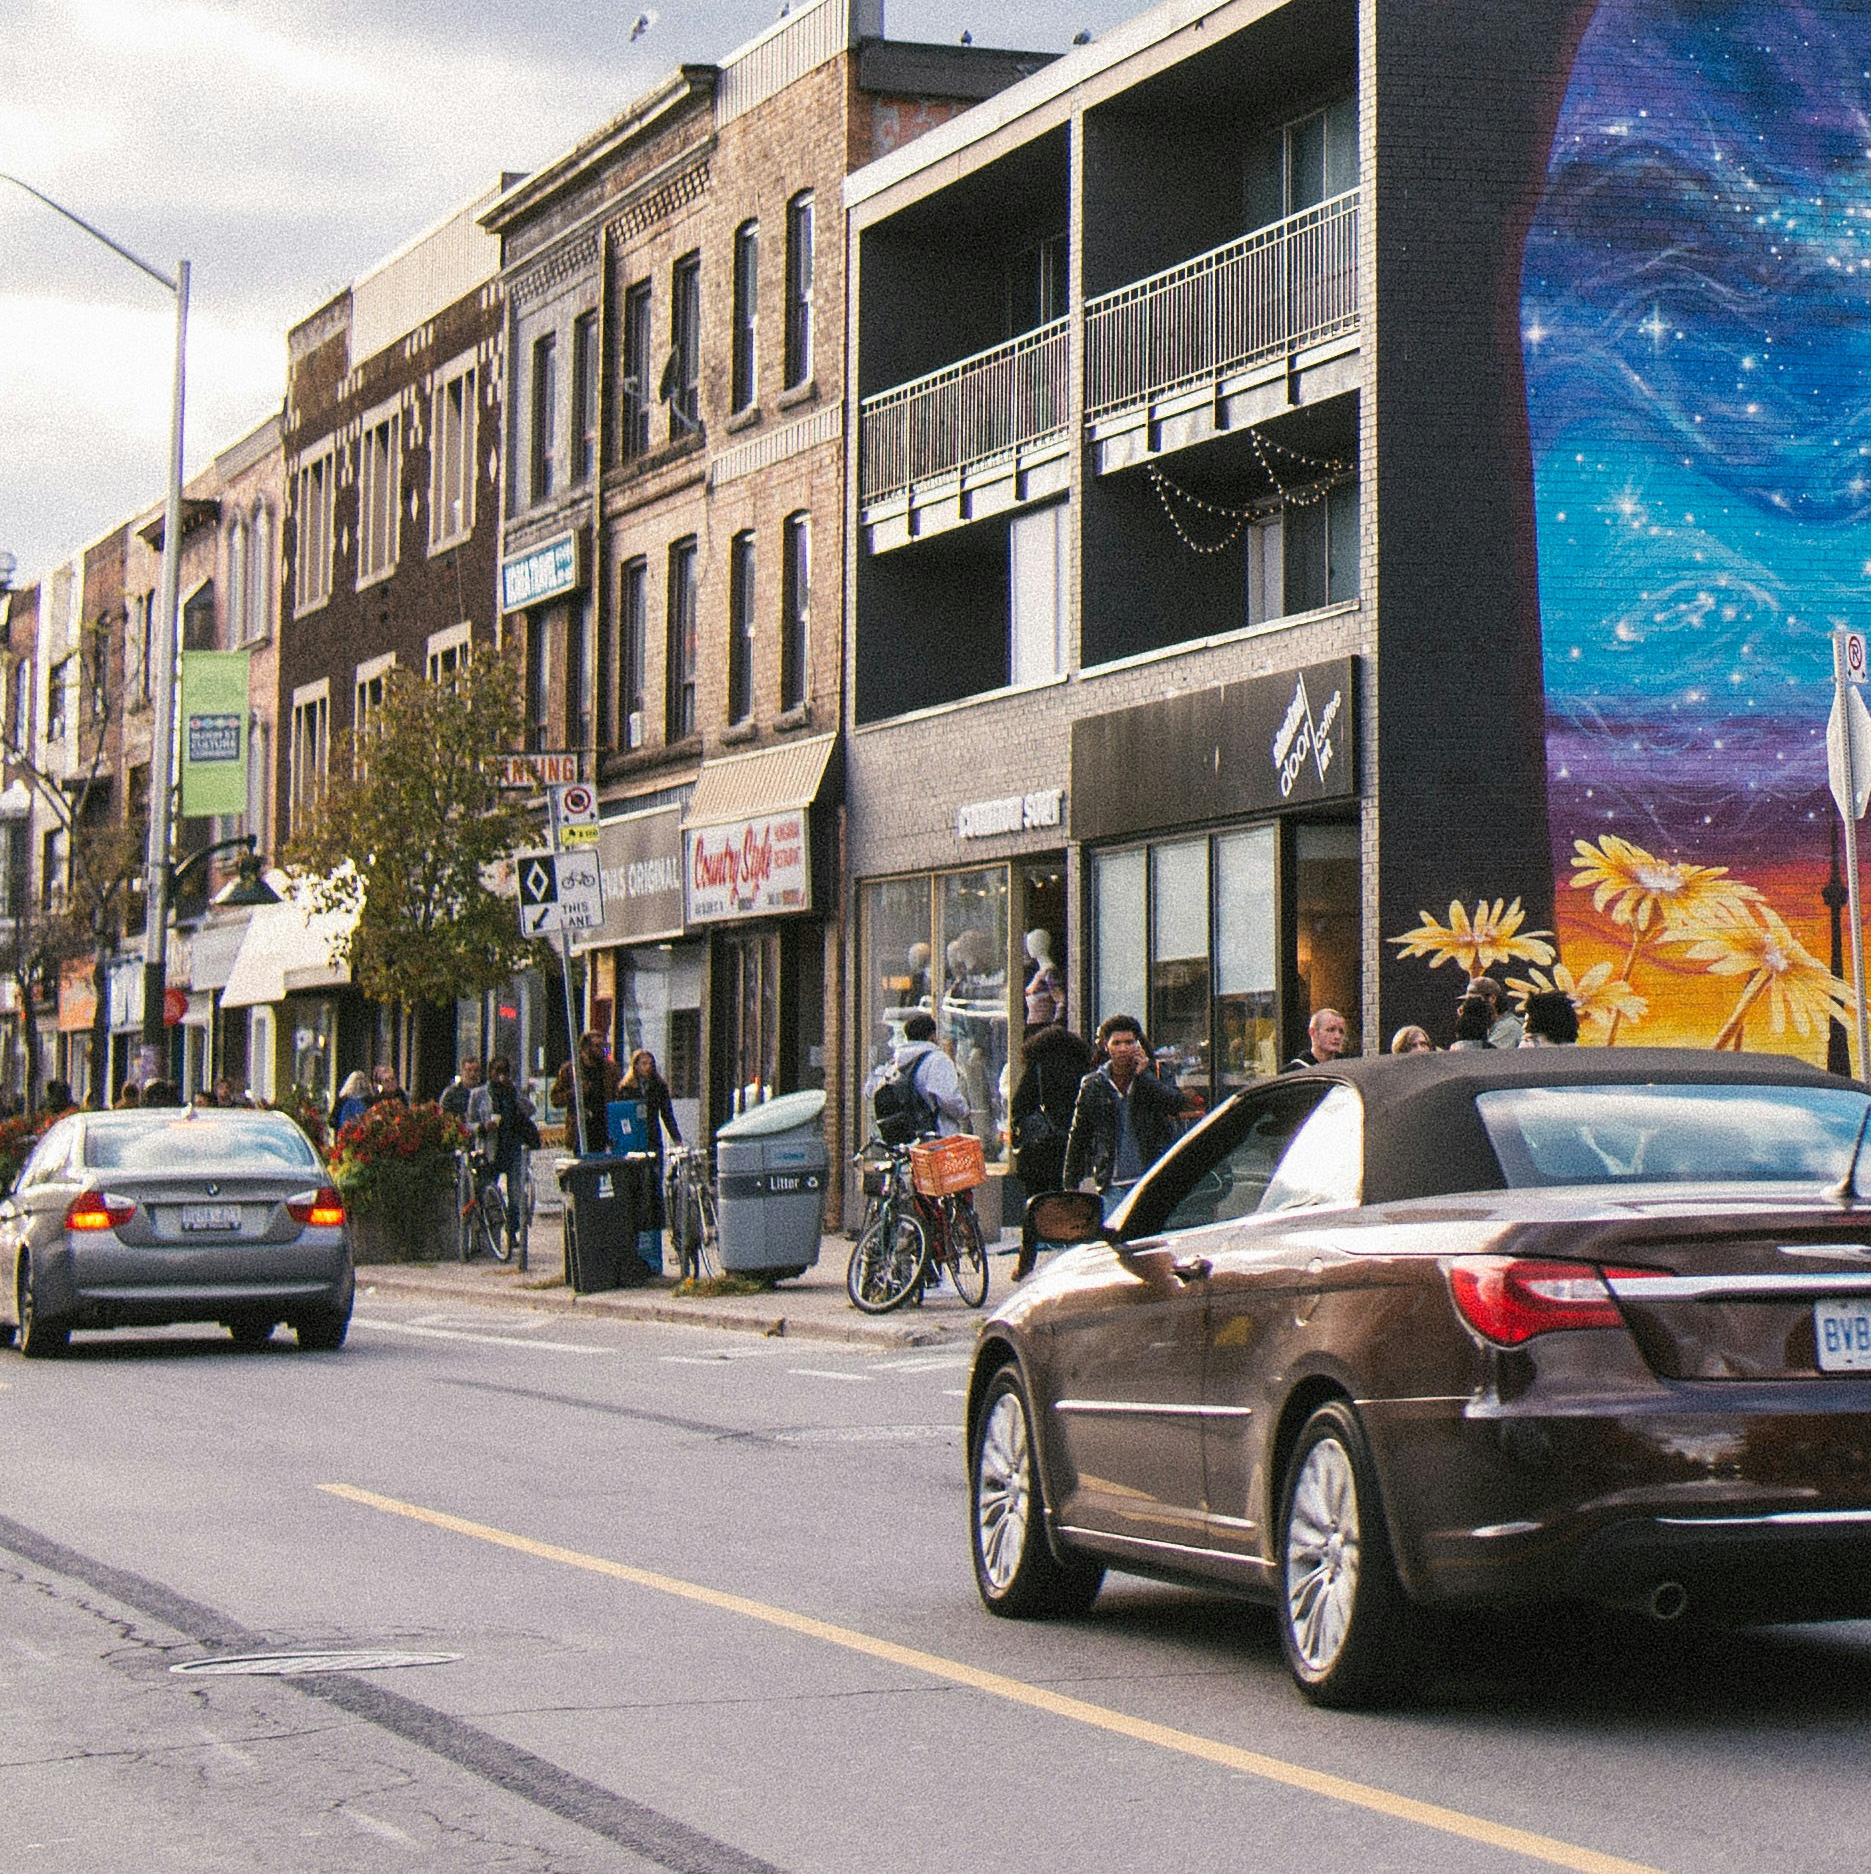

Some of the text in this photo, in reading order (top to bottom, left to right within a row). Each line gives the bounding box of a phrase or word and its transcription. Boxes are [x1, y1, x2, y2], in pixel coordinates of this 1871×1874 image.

[1280, 720, 1311, 798] door
[694, 832, 741, 906] Country
[740, 822, 772, 904] Style
[562, 900, 589, 915] THIS
[560, 914, 592, 928] LANE
[770, 1175, 800, 1192] Litter
